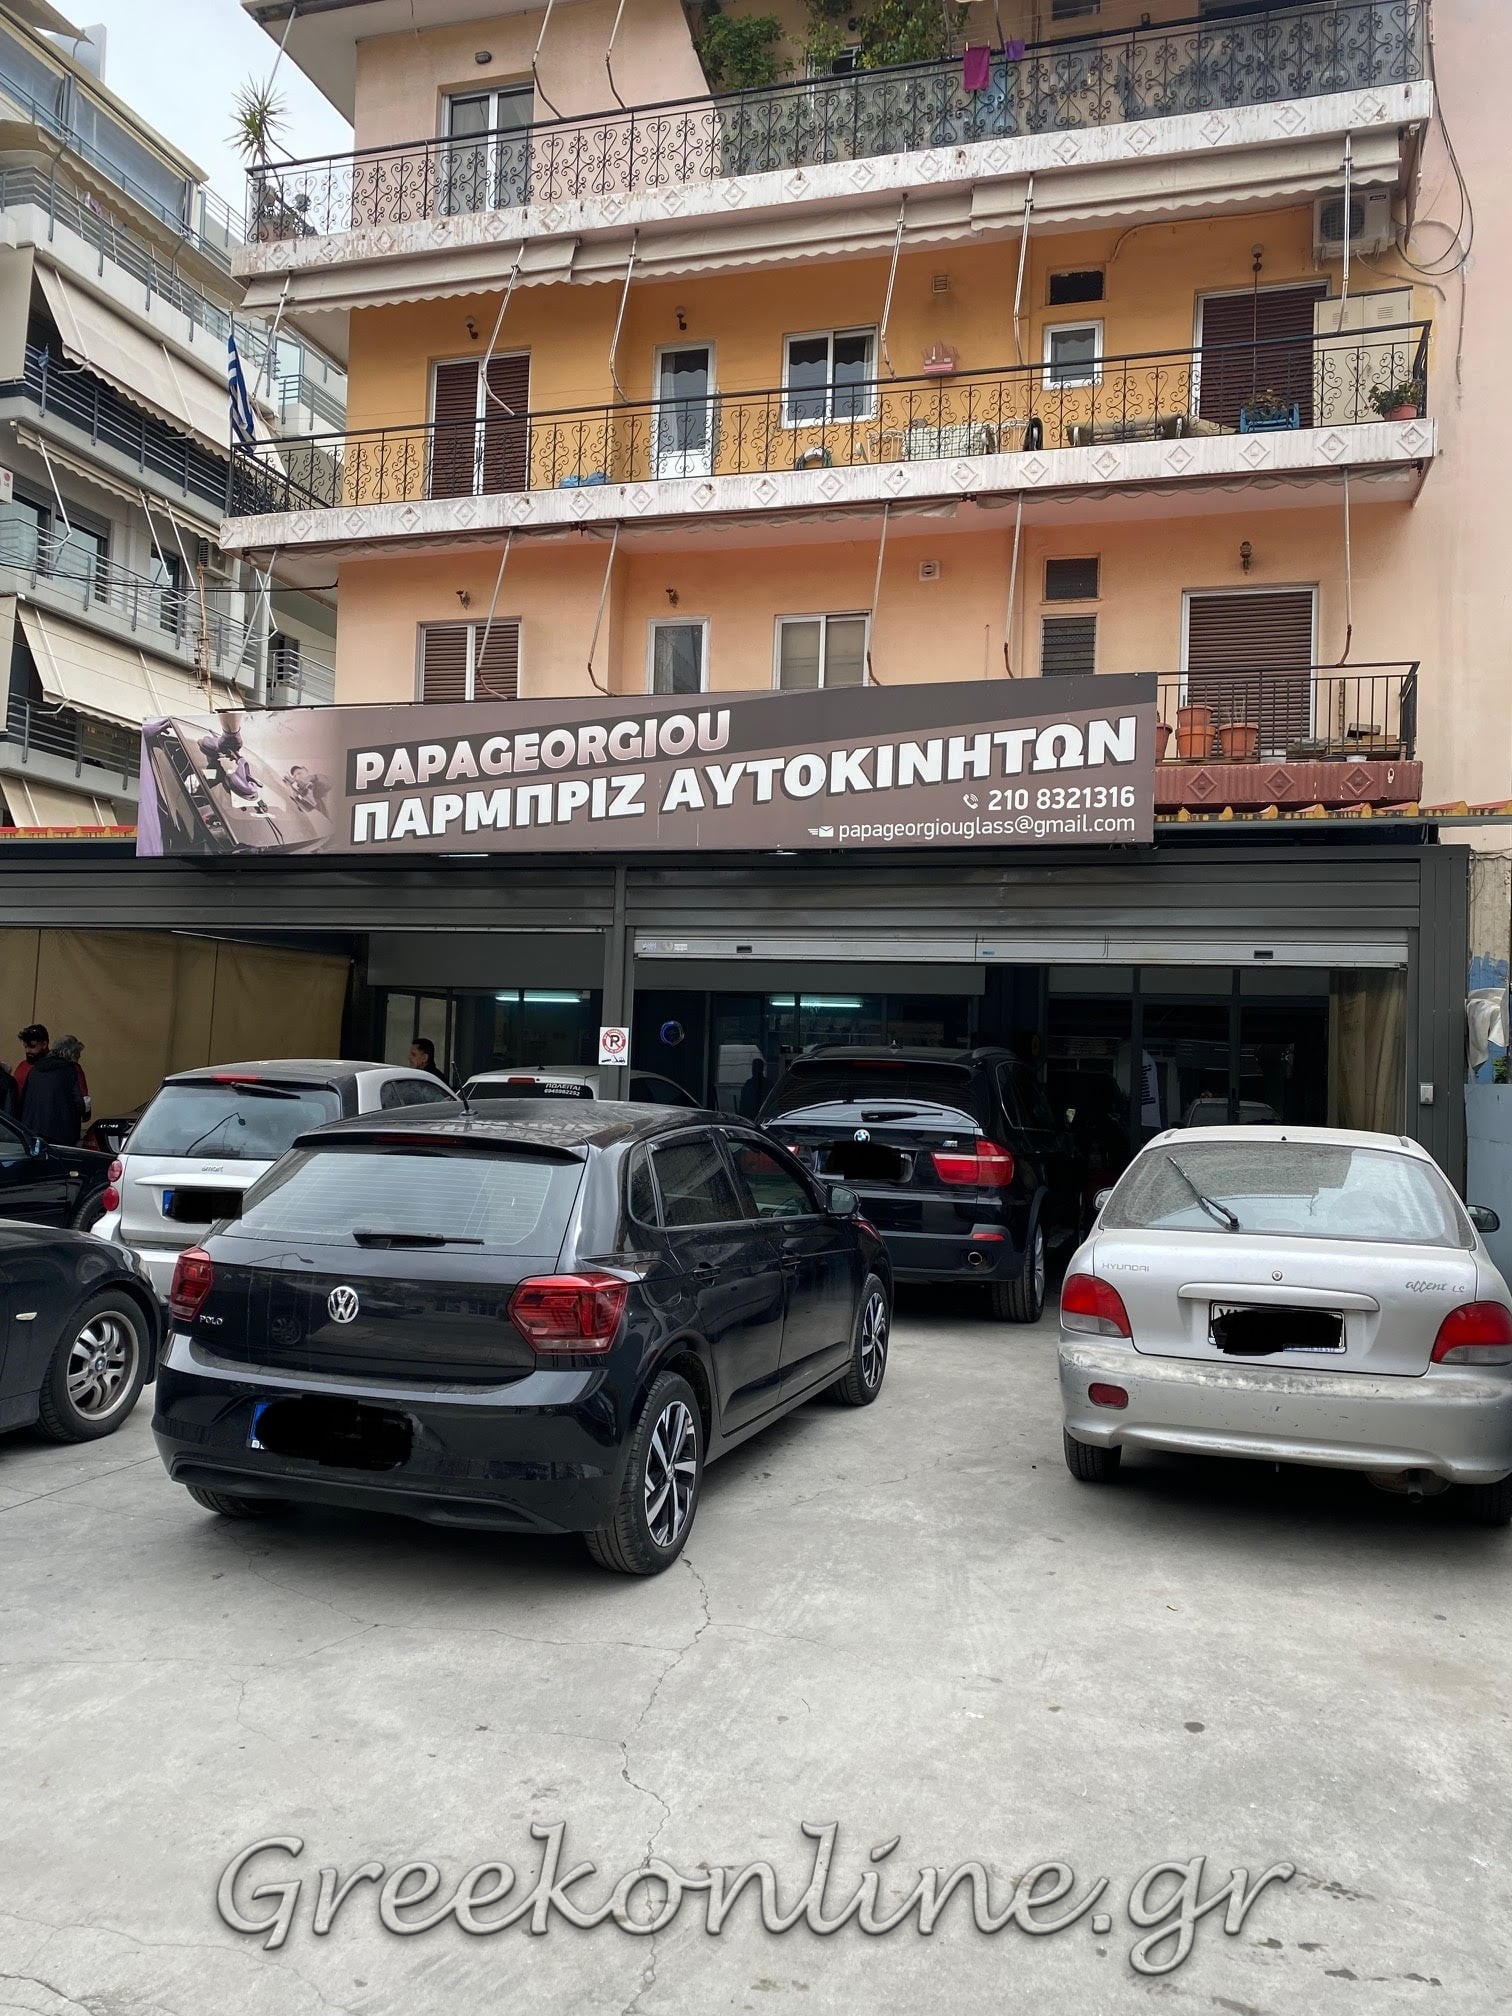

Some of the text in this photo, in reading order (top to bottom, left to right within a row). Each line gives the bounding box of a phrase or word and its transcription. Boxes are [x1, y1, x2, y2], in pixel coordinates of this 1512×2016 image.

[356, 709, 731, 790] PAPAGEORGIOU
[353, 715, 1137, 843] ΠΑΡΜΠΡΙΖ ΑΥΤΟΚΙΝΗΤΩΝ
[988, 785, 1136, 811] 210 8321316
[838, 815, 1136, 842] papageorgiouglass@gmail.com
[1102, 1262, 1150, 1272] HYUNDAI
[199, 1314, 223, 1326] POLO
